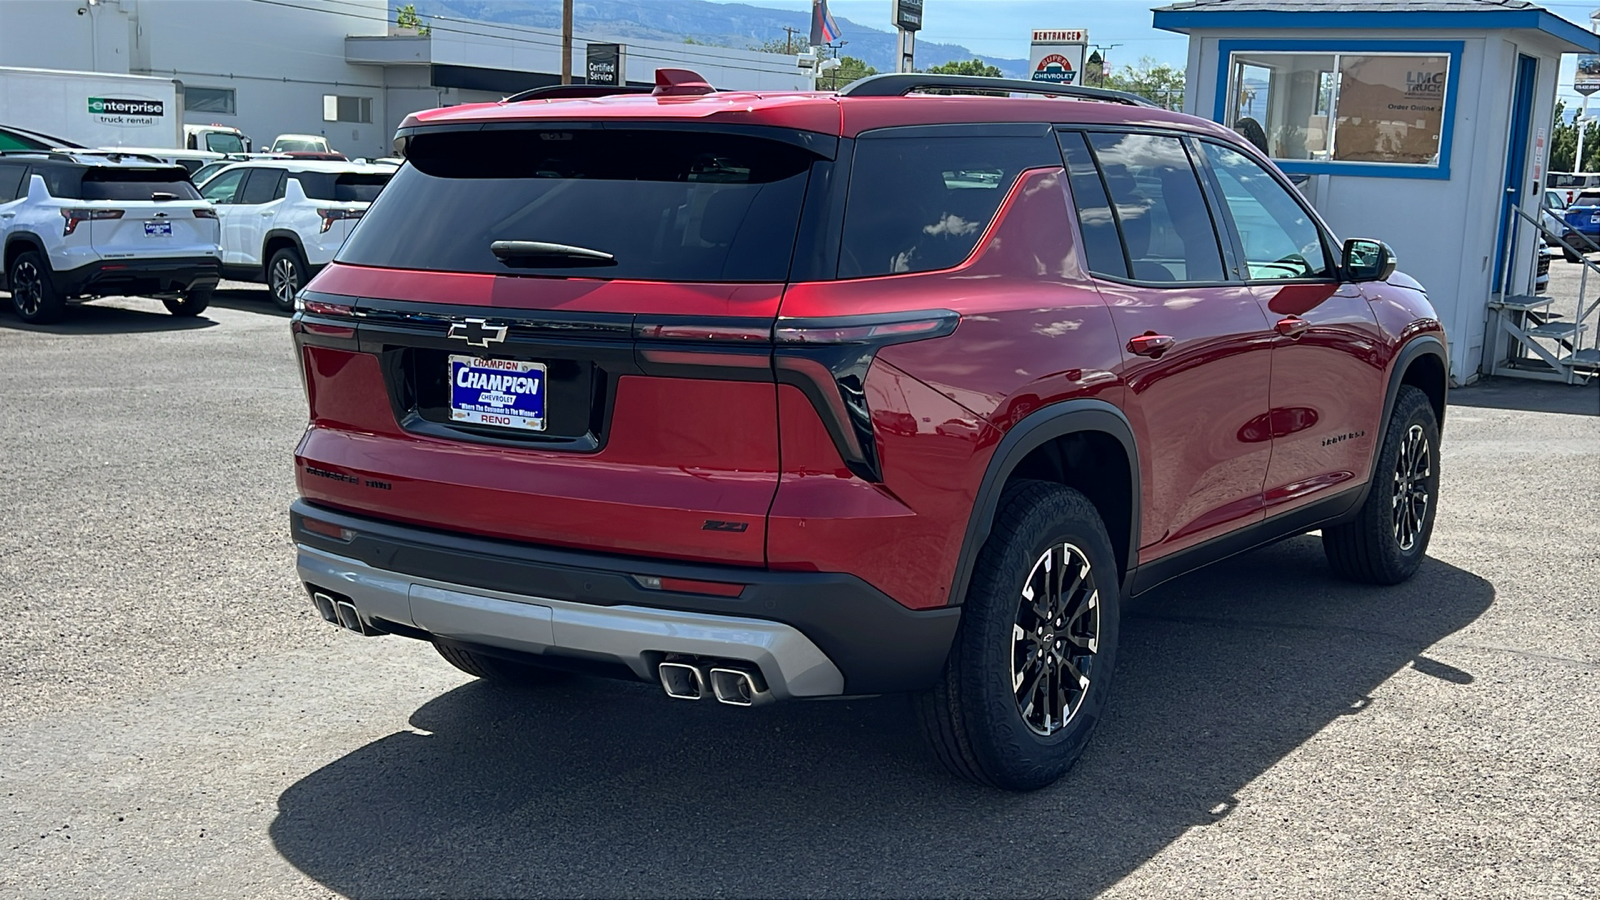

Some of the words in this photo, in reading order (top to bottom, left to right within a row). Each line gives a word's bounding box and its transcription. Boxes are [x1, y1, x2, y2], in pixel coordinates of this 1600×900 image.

[1038, 31, 1076, 41] ENTRANCE
[1041, 54, 1068, 67] SUPER
[589, 62, 614, 72] Certified
[590, 71, 613, 81] Service
[1406, 71, 1444, 84] LMC
[1405, 83, 1442, 92] TRUCK
[90, 101, 163, 114] enterprise
[1387, 103, 1409, 111] Order
[1410, 104, 1435, 112] Online
[100, 116, 124, 124] truck
[126, 117, 153, 125] rental
[473, 359, 518, 370] CHAMPION
[457, 367, 539, 395] CHAMPION
[481, 394, 513, 403] CHEVROLET
[481, 414, 511, 425] RENO
